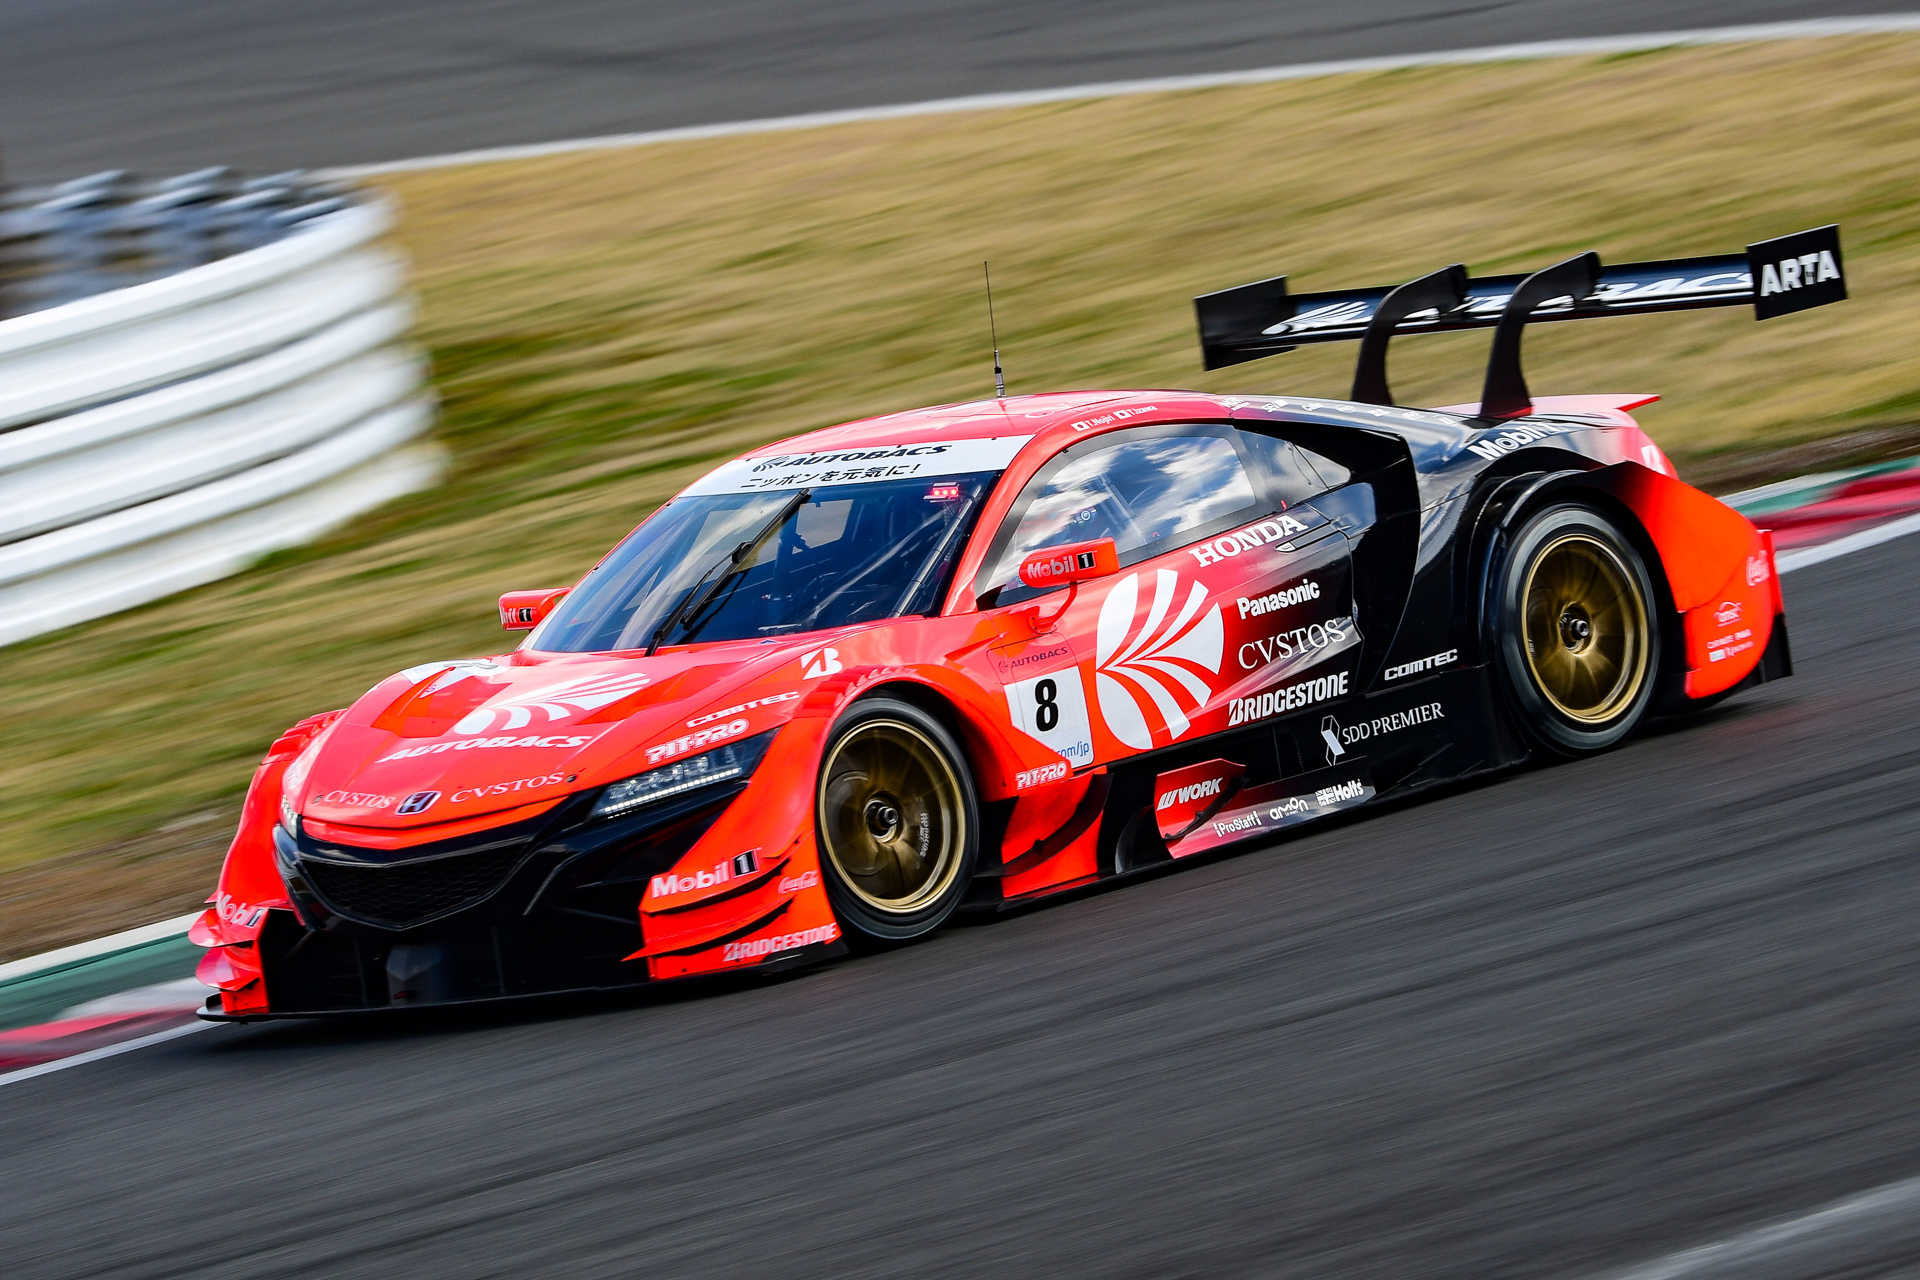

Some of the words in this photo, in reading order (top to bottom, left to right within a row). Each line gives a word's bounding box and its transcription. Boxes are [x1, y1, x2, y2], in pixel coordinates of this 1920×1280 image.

[1760, 250, 1841, 297] ARTA
[783, 445, 952, 467] AUTOBACS
[1467, 425, 1549, 460] Mobil
[1188, 514, 1309, 567] HONDA
[1027, 555, 1076, 580] Mobil
[1078, 552, 1093, 569] 1
[1236, 579, 1320, 619] Panasonic
[1011, 647, 1068, 668] AUTOBACS
[1238, 618, 1346, 669] CVSTOS
[1384, 649, 1458, 681] COMTEC
[686, 691, 800, 728] COMTEC
[1035, 679, 1059, 732] 8
[1228, 671, 1349, 727] BRIDGESTONE
[1342, 723, 1371, 745] SDD
[1371, 702, 1445, 737] PREMIER
[376, 735, 594, 763] AUTOBACS
[324, 790, 396, 810] CVSTOS
[450, 772, 565, 803] CVSTOS
[1179, 777, 1223, 804] WORK
[1334, 779, 1365, 803] Holts
[651, 861, 729, 898] Mobil
[723, 922, 837, 962] BRIDGESTONE
